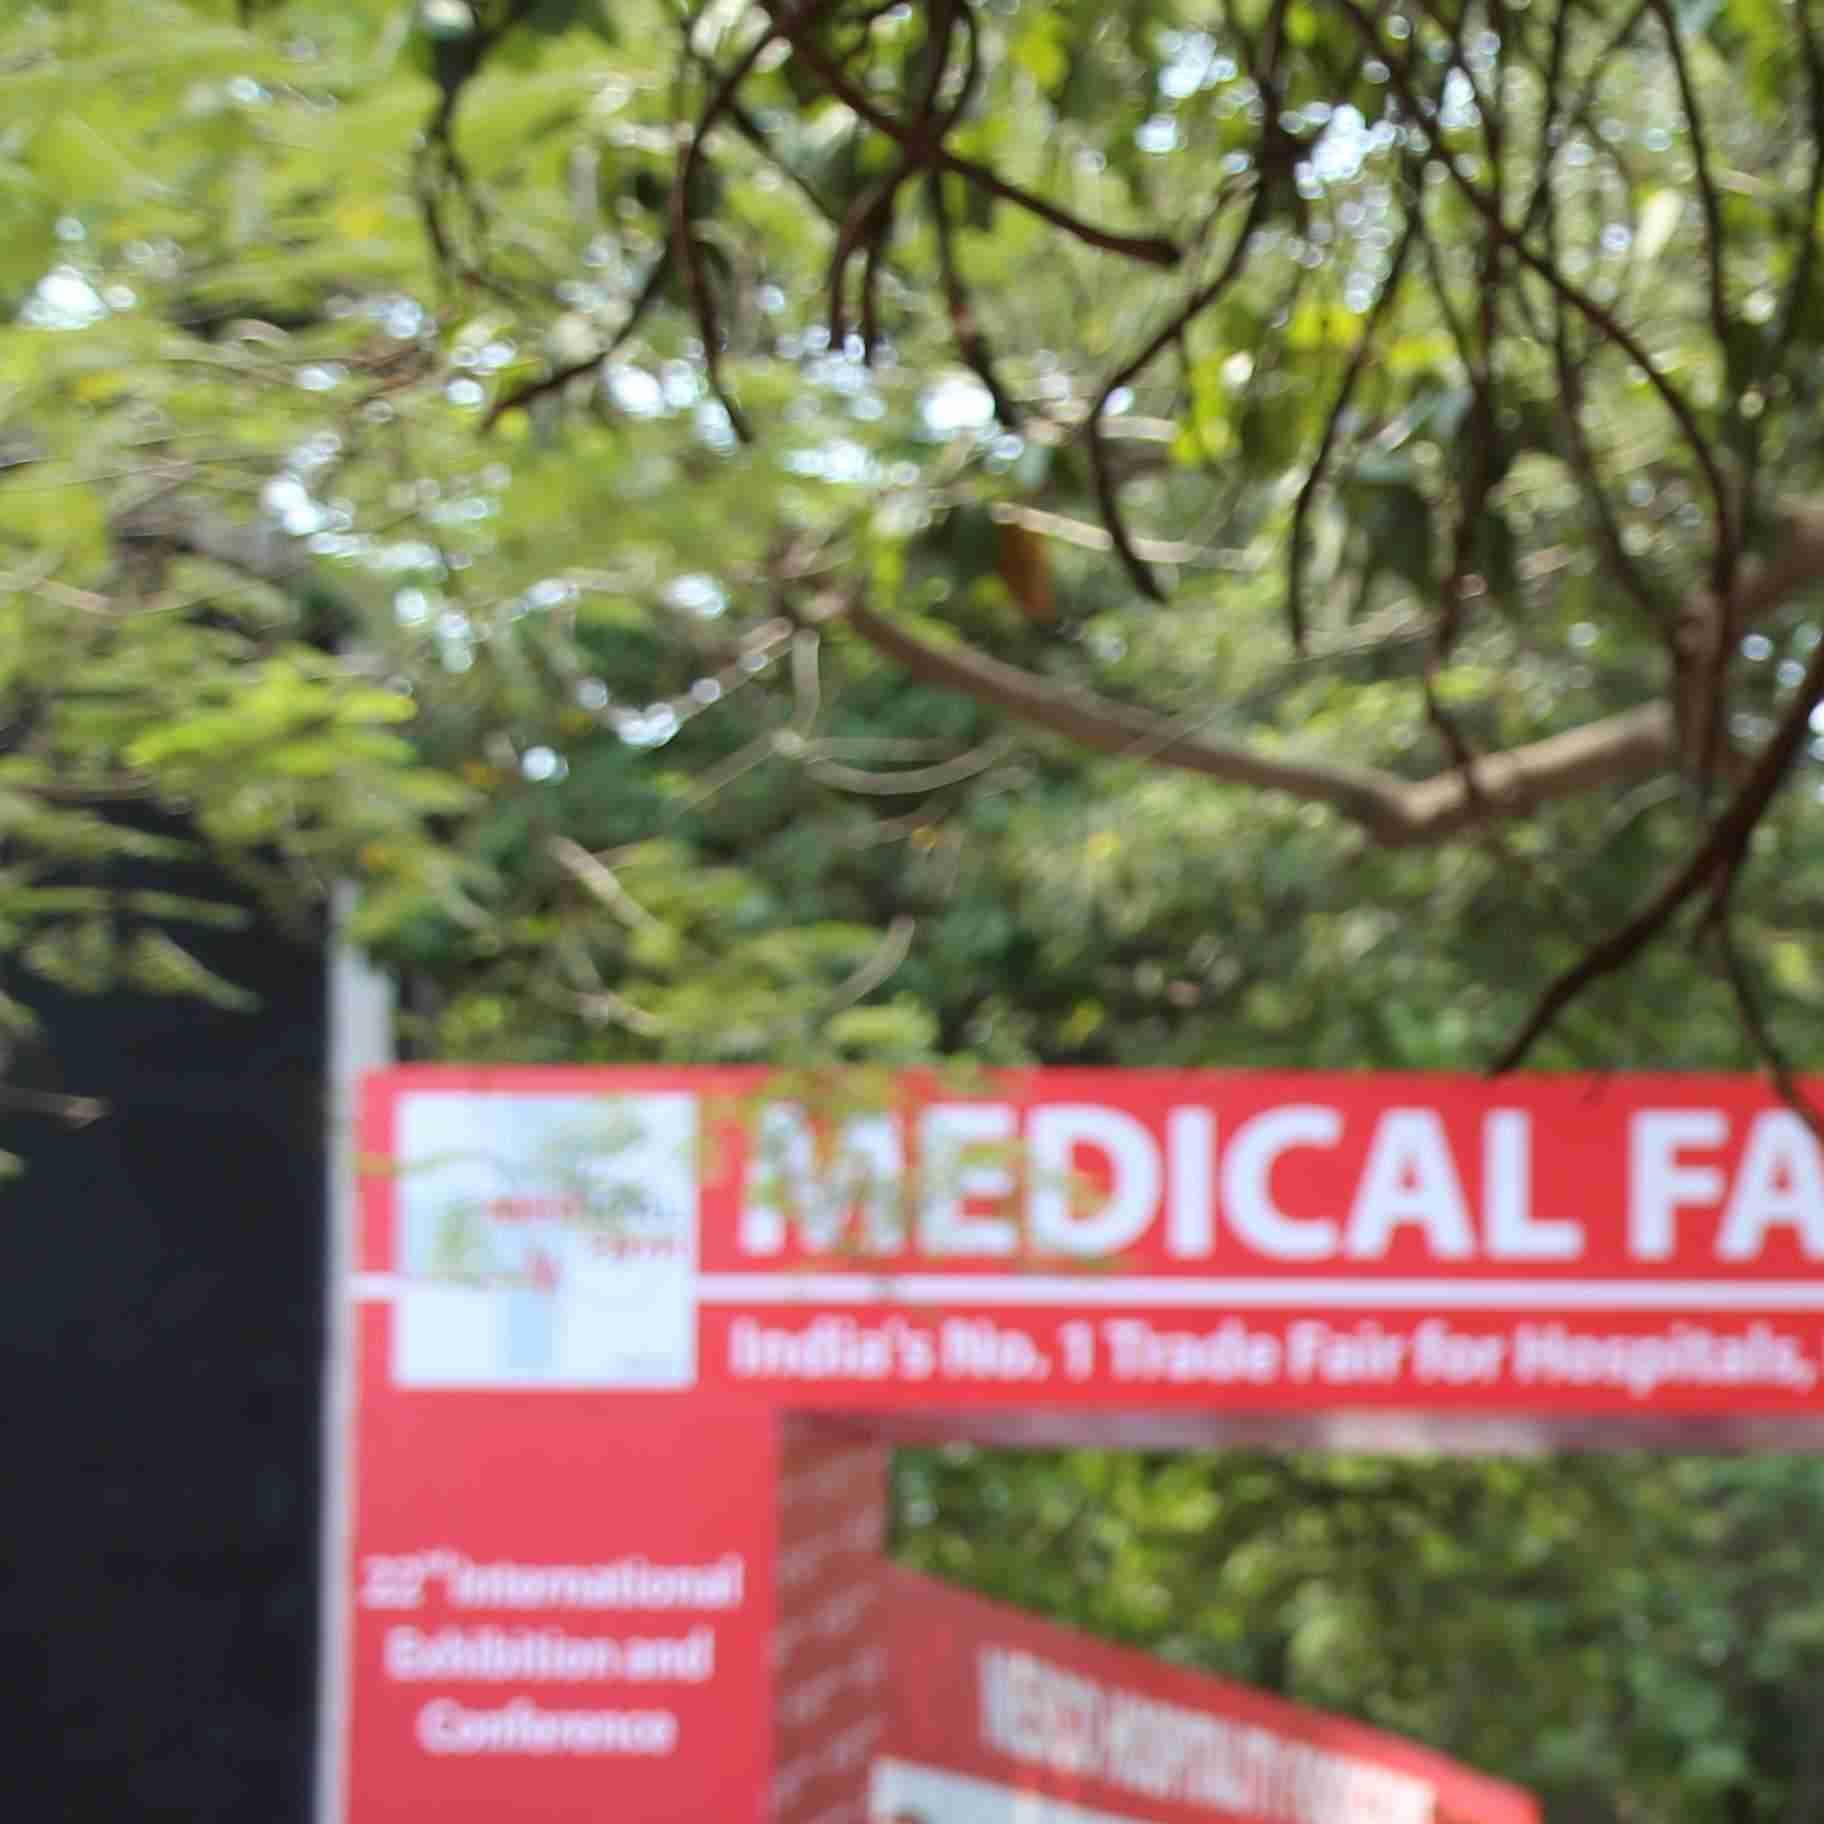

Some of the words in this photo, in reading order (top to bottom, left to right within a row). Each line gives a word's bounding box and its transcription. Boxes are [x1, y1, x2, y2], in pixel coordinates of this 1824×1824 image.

[737, 1098, 1584, 1262] MEDICAL
[728, 1313, 933, 1381] India's
[941, 1314, 1050, 1382] No.
[1058, 1317, 1093, 1383] 1
[1103, 1316, 1282, 1384] Trade
[1286, 1318, 1405, 1385] Fair
[1412, 1317, 1503, 1386] for
[1513, 1320, 1817, 1398] Hospitals,
[454, 1552, 745, 1611] International
[385, 1623, 621, 1682] Exhibition
[625, 1623, 714, 1681] and
[416, 1696, 679, 1757] Conference
